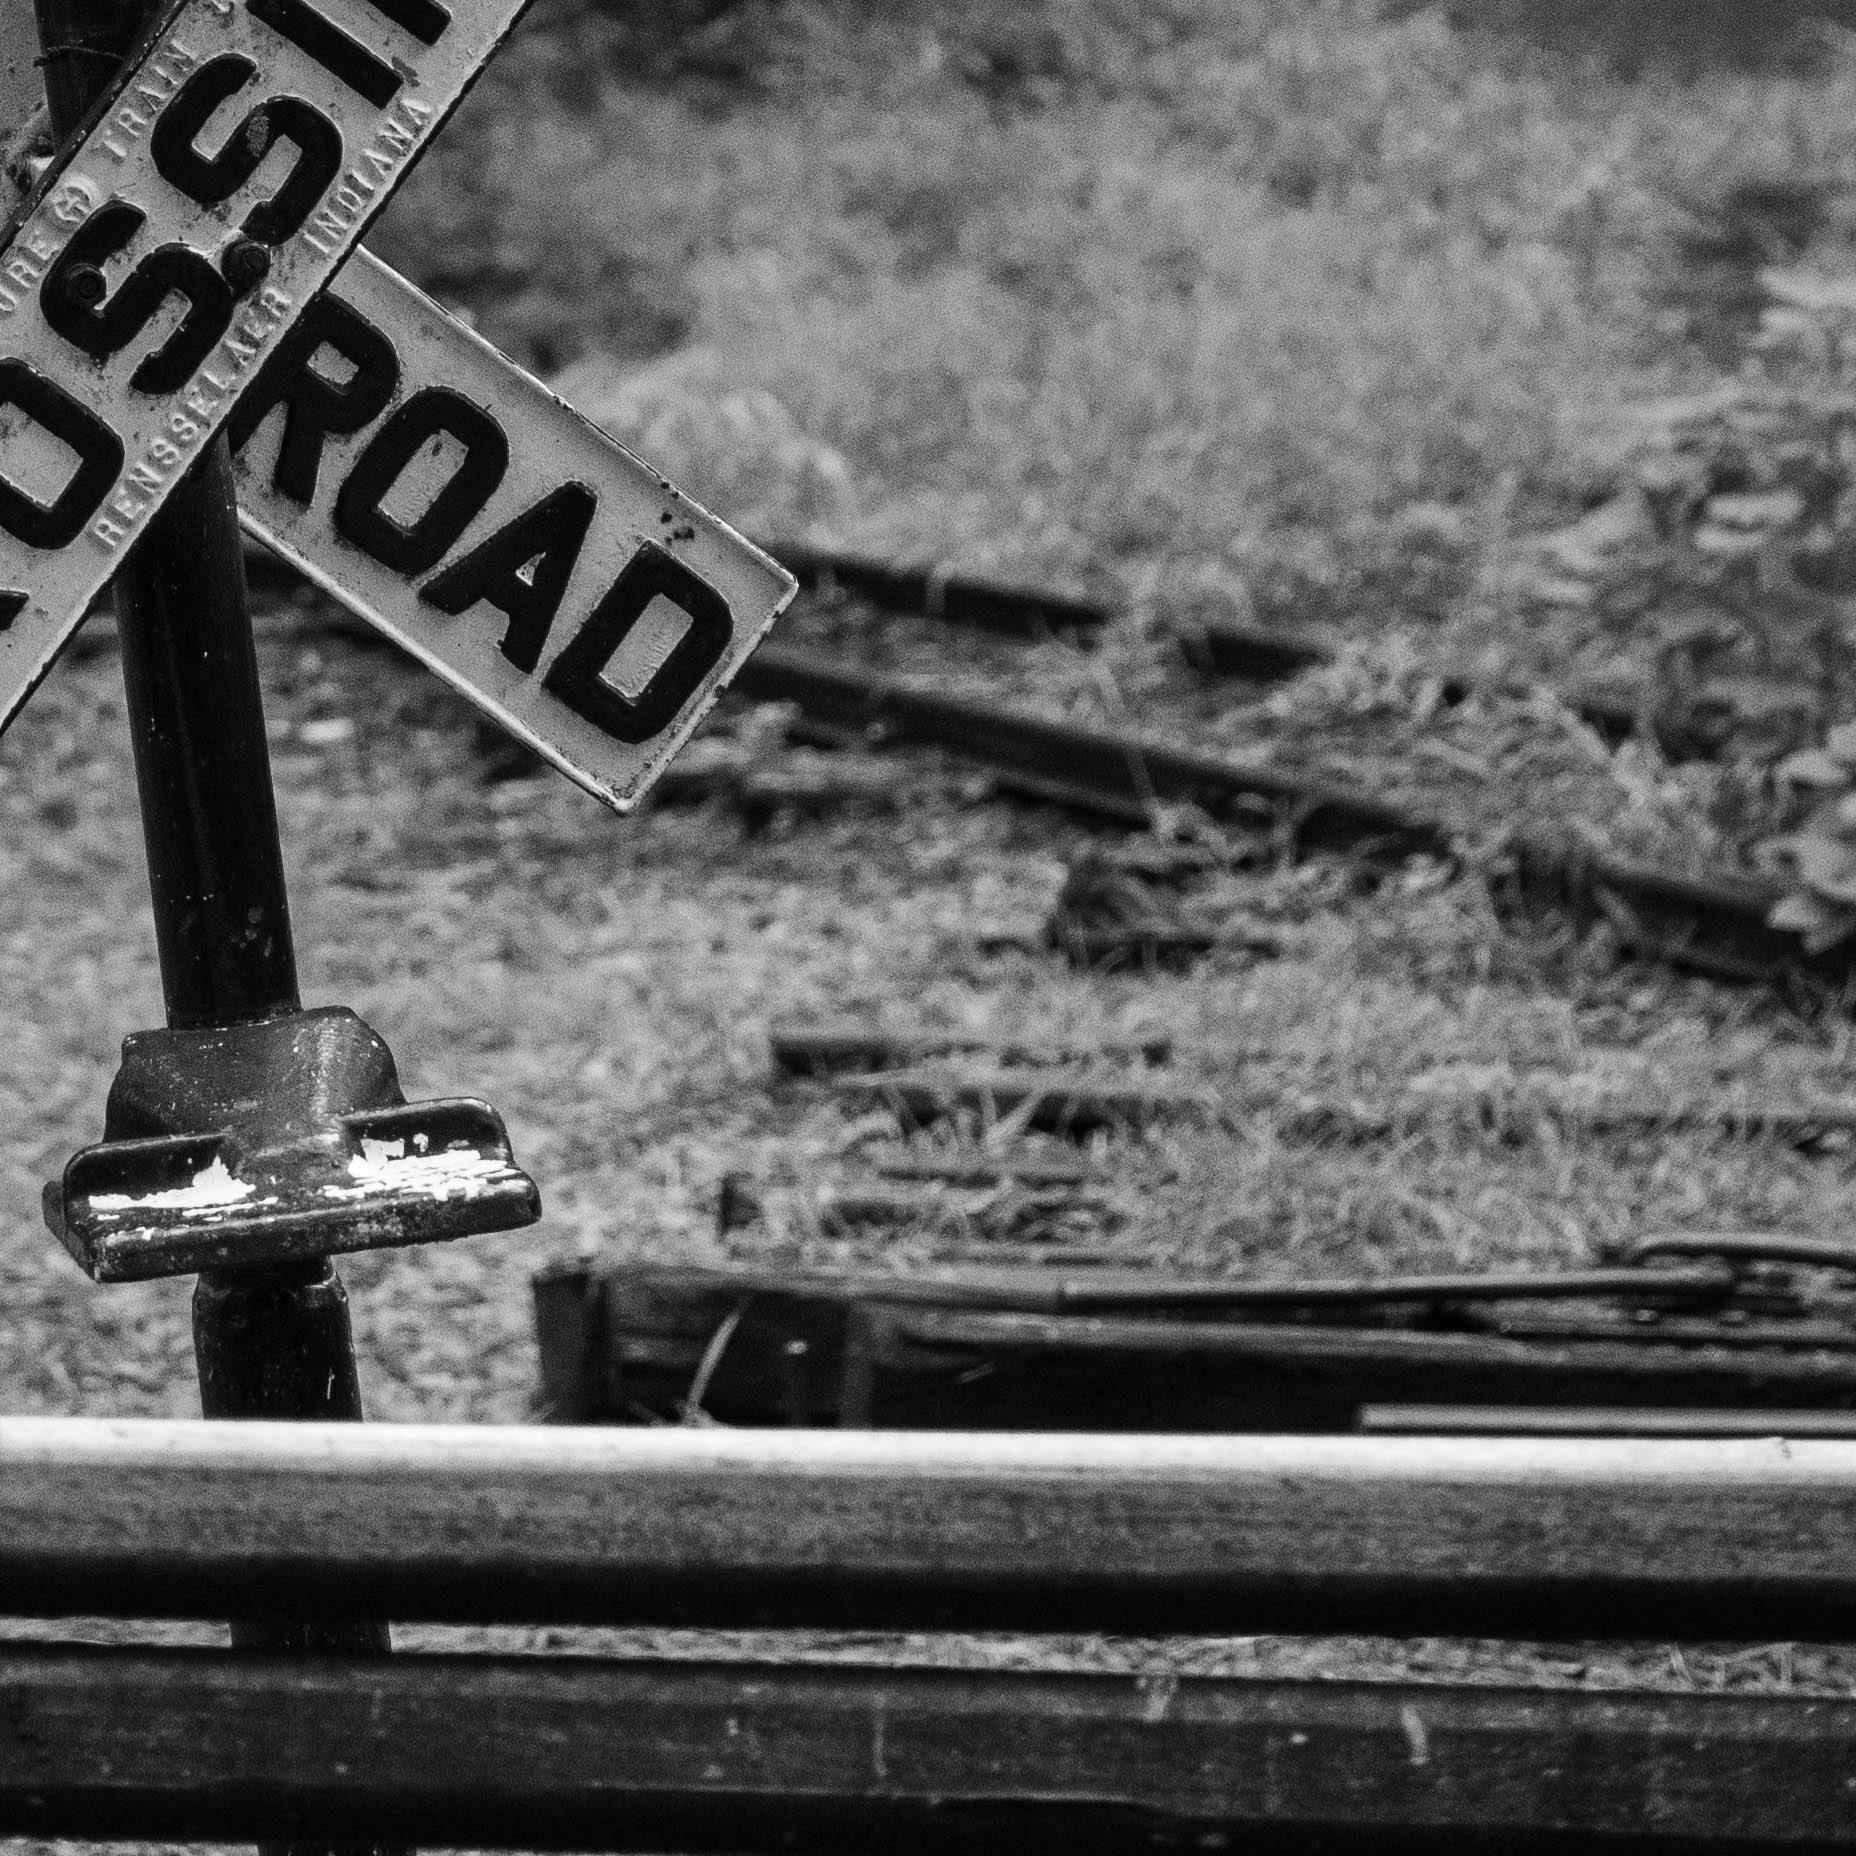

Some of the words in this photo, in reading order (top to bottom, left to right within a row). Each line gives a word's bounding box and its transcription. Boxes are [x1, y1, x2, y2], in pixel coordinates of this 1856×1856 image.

[93, 286, 294, 548] RENSSELAER
[301, 98, 434, 254] INDIANA
[102, 40, 197, 158] TRAIN
[230, 290, 734, 744] ROAD
